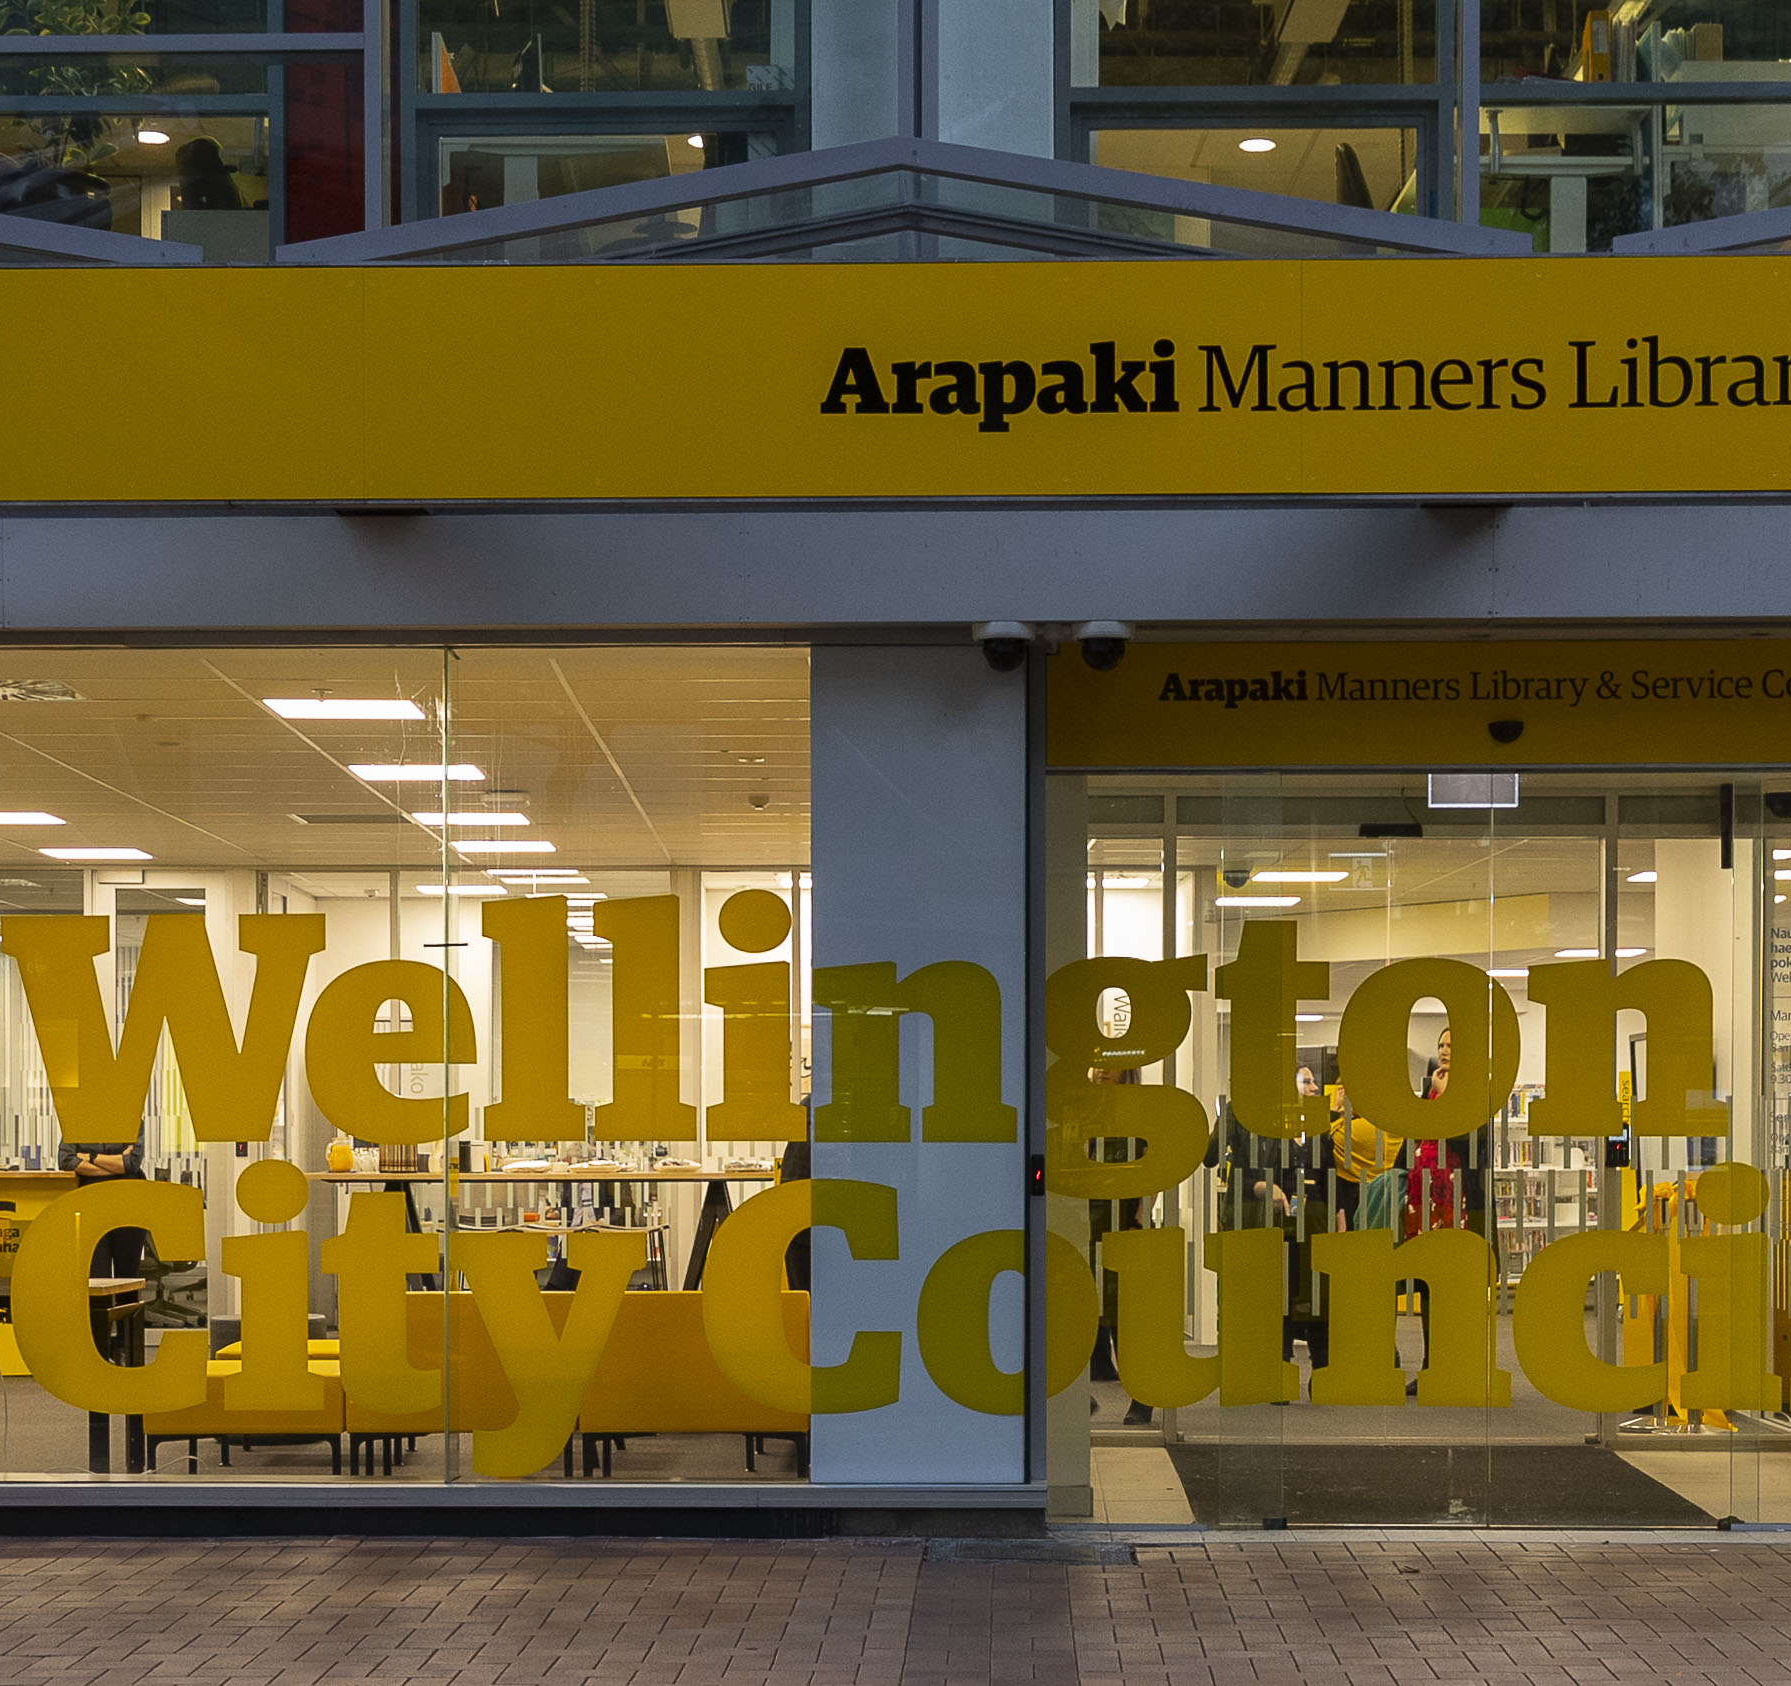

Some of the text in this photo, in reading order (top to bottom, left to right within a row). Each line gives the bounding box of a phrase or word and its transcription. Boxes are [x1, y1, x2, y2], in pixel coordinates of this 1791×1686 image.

[819, 338, 1180, 433] Arapaki
[1197, 344, 1547, 413] Manners
[1159, 669, 1308, 710] Arapaki
[1316, 671, 1461, 701] Manners
[1469, 669, 1590, 707] Library
[1596, 670, 1622, 700] &
[1631, 670, 1753, 700] Service
[1, 888, 1731, 1200] Wellington
[11, 1159, 647, 1478] City
